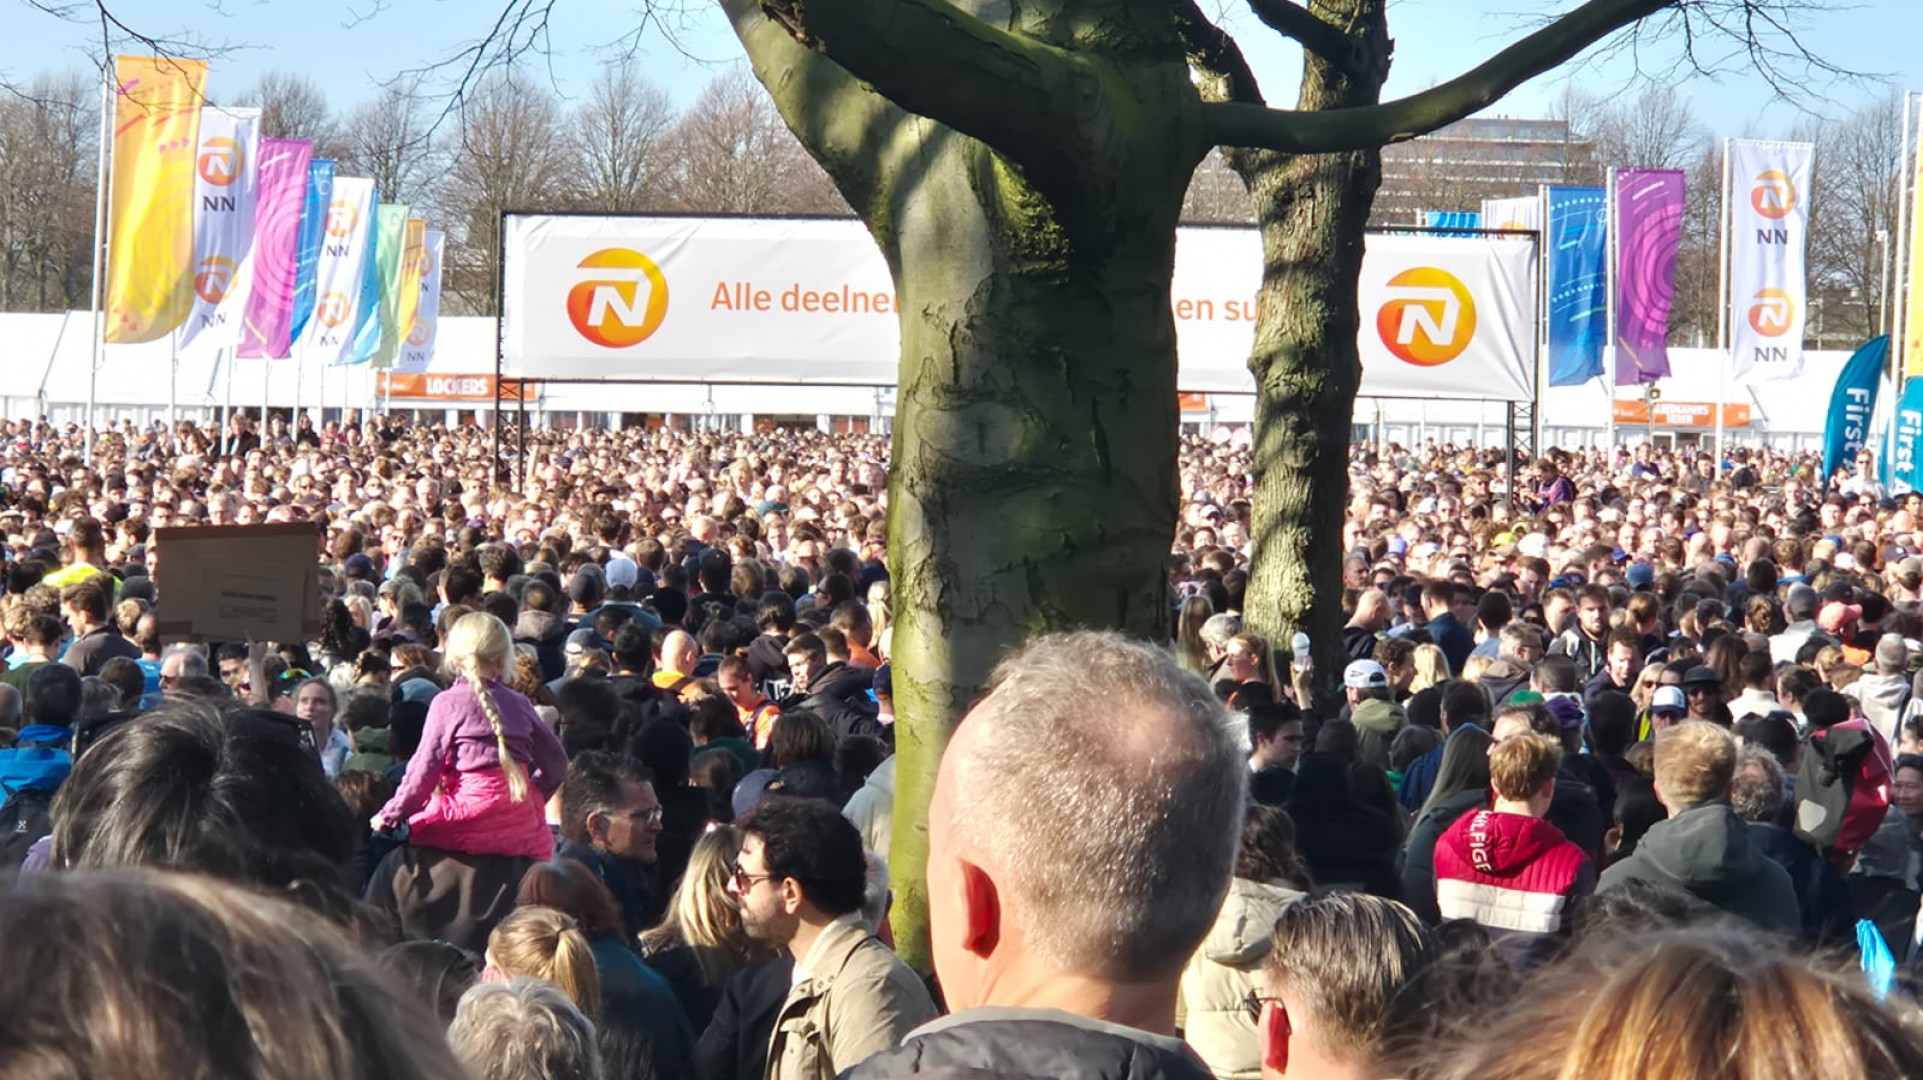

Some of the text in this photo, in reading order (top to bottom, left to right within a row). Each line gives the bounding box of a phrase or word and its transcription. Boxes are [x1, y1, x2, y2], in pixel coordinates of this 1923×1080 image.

[203, 196, 236, 212] NN
[1756, 229, 1788, 245] NN
[326, 245, 350, 257] NN
[711, 281, 772, 312] Alle
[1175, 299, 1213, 321] en
[201, 312, 227, 329] NN
[407, 352, 426, 362] NN
[1754, 347, 1788, 362] NN
[426, 377, 488, 396] LOCKERS
[1844, 387, 1871, 452] First
[1896, 409, 1923, 474] First
